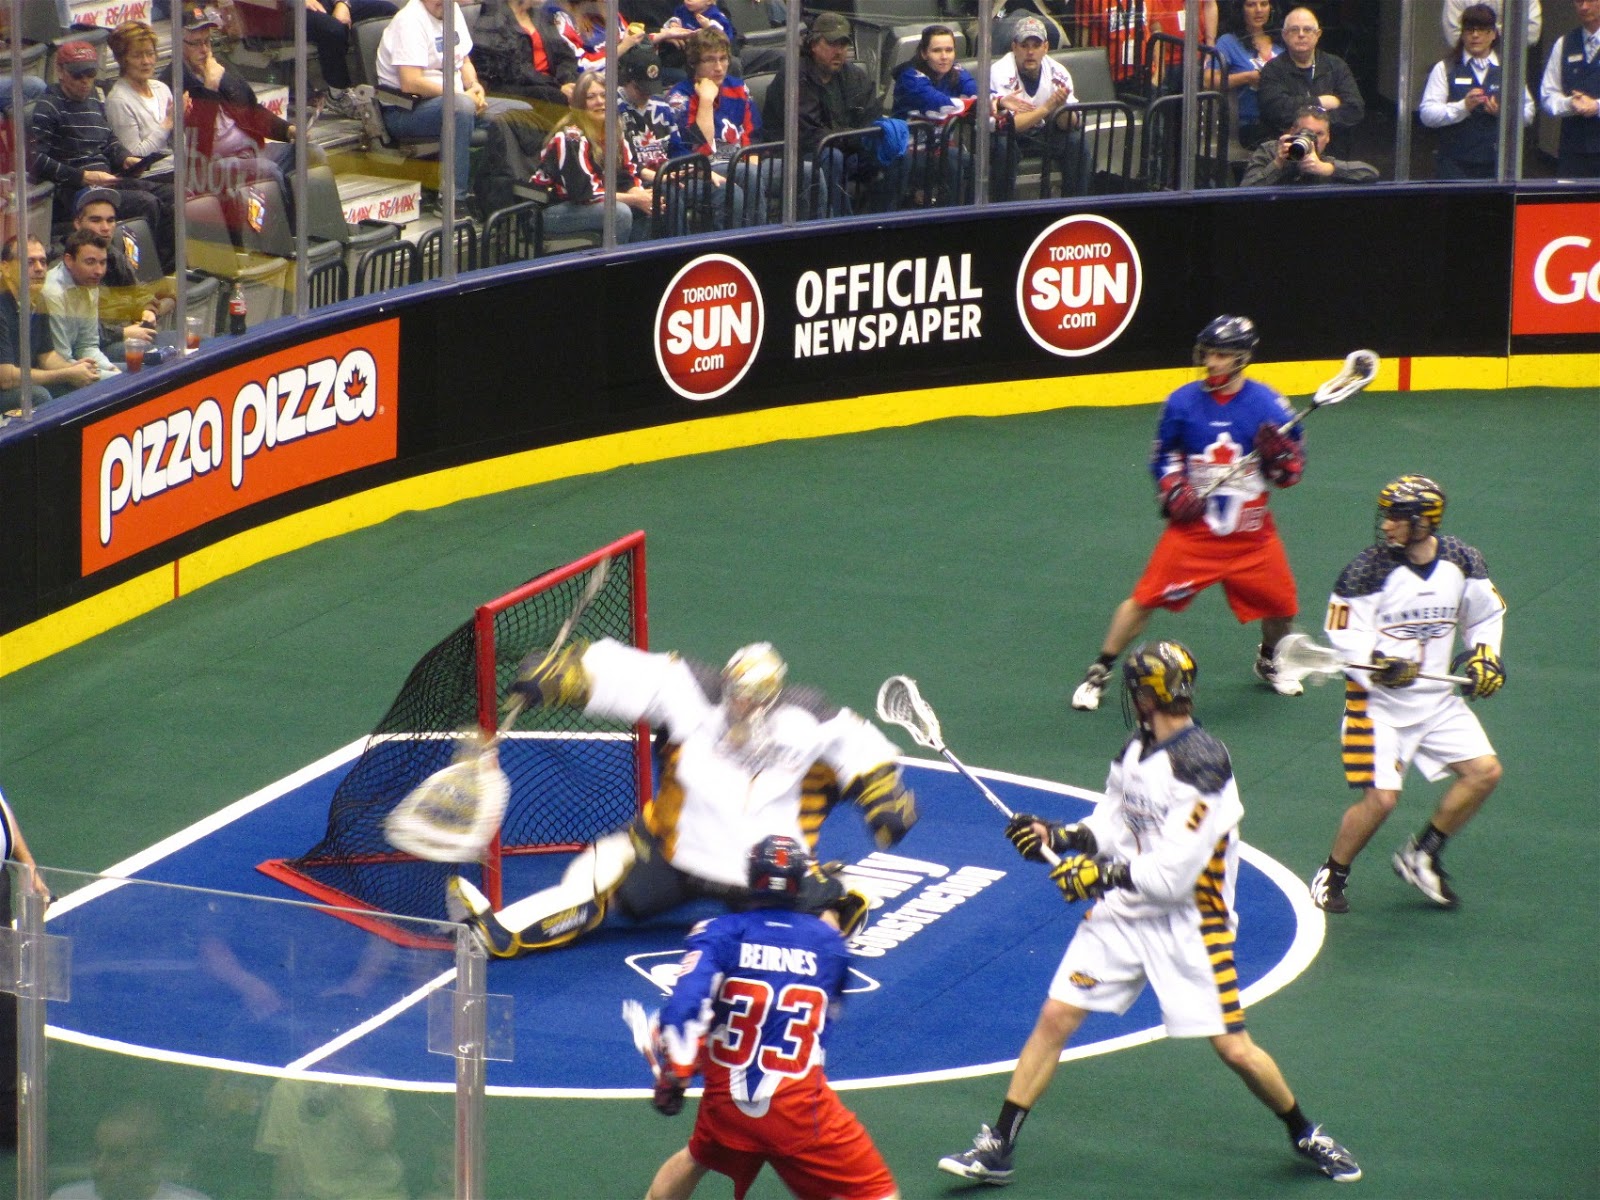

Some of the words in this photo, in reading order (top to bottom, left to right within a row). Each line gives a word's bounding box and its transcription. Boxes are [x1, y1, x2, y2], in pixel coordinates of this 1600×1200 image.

[378, 193, 416, 219] RE/MAX
[1049, 242, 1111, 262] TORONTO
[682, 282, 737, 304] TORONTO
[795, 253, 982, 318] OFFICIAL
[1030, 262, 1128, 311] SUN
[666, 301, 752, 355] SUN
[794, 303, 982, 358] NEWSPAPER
[1057, 311, 1097, 329] .com
[690, 353, 724, 373] .com
[739, 942, 819, 977] BEIRNES
[709, 976, 829, 1080] 33
